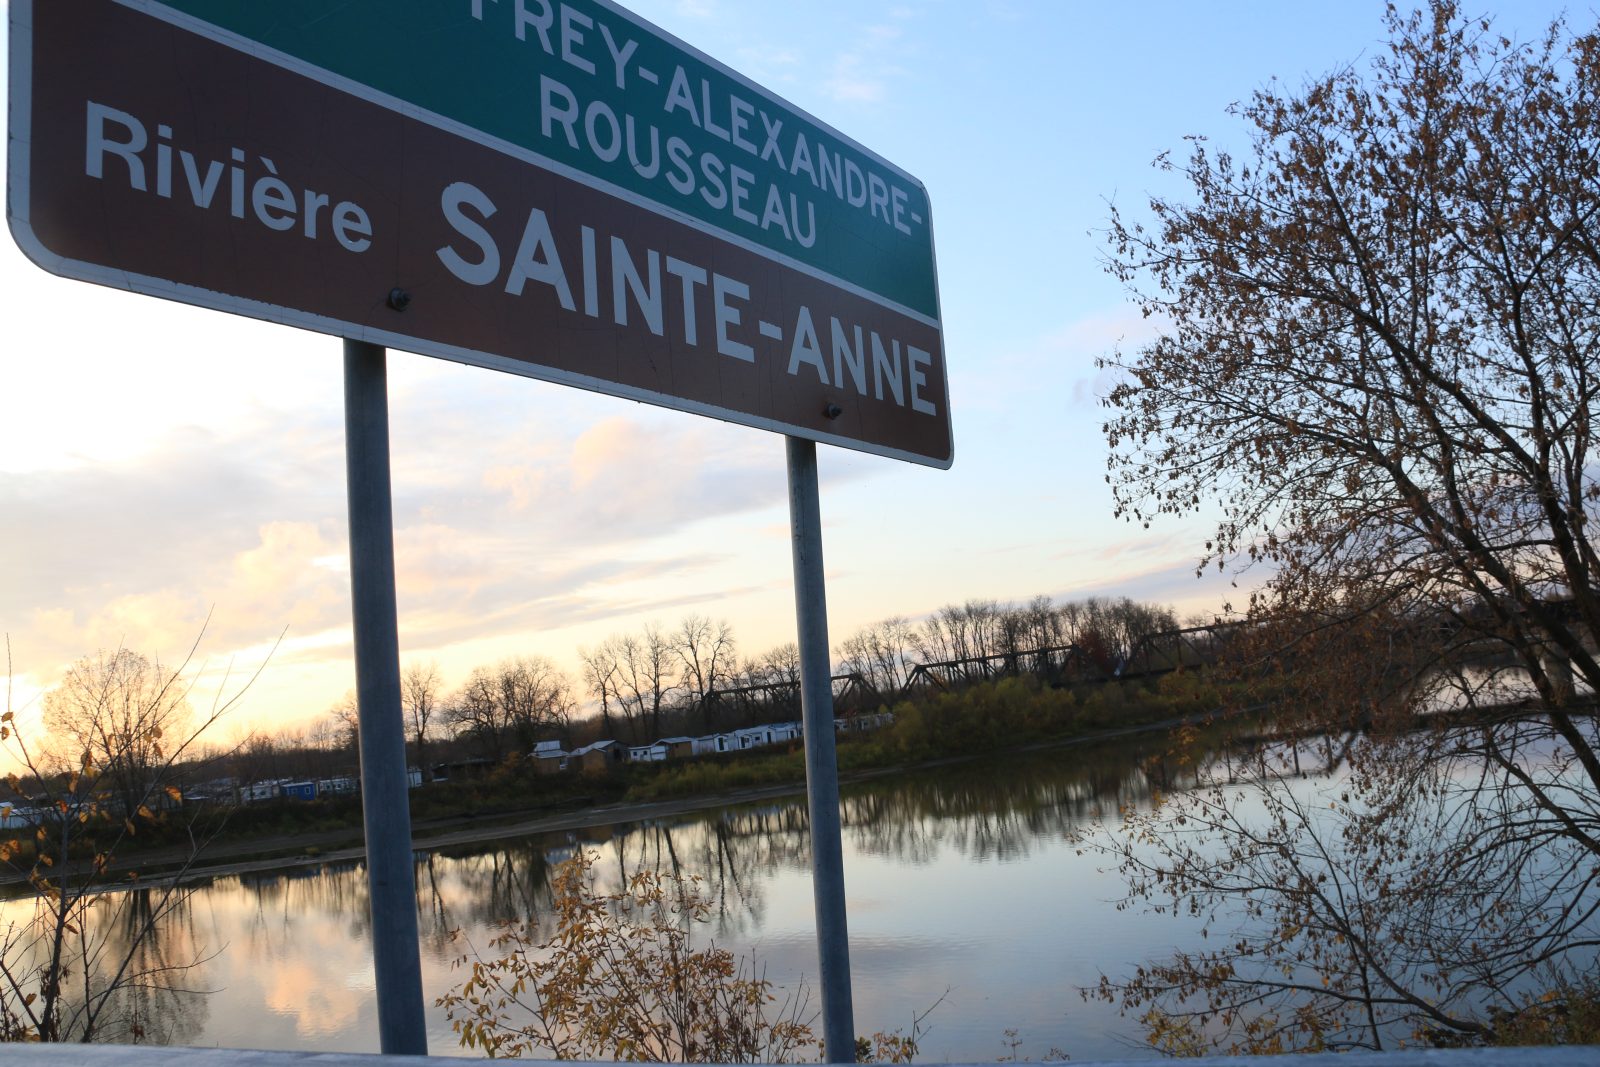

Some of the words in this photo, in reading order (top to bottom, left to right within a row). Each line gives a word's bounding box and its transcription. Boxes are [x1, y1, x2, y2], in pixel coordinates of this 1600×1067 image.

[86, 100, 373, 253] Rivière
[436, 181, 937, 416] SAINTE-ANNE
[540, 74, 816, 248] ROUSSEAU
